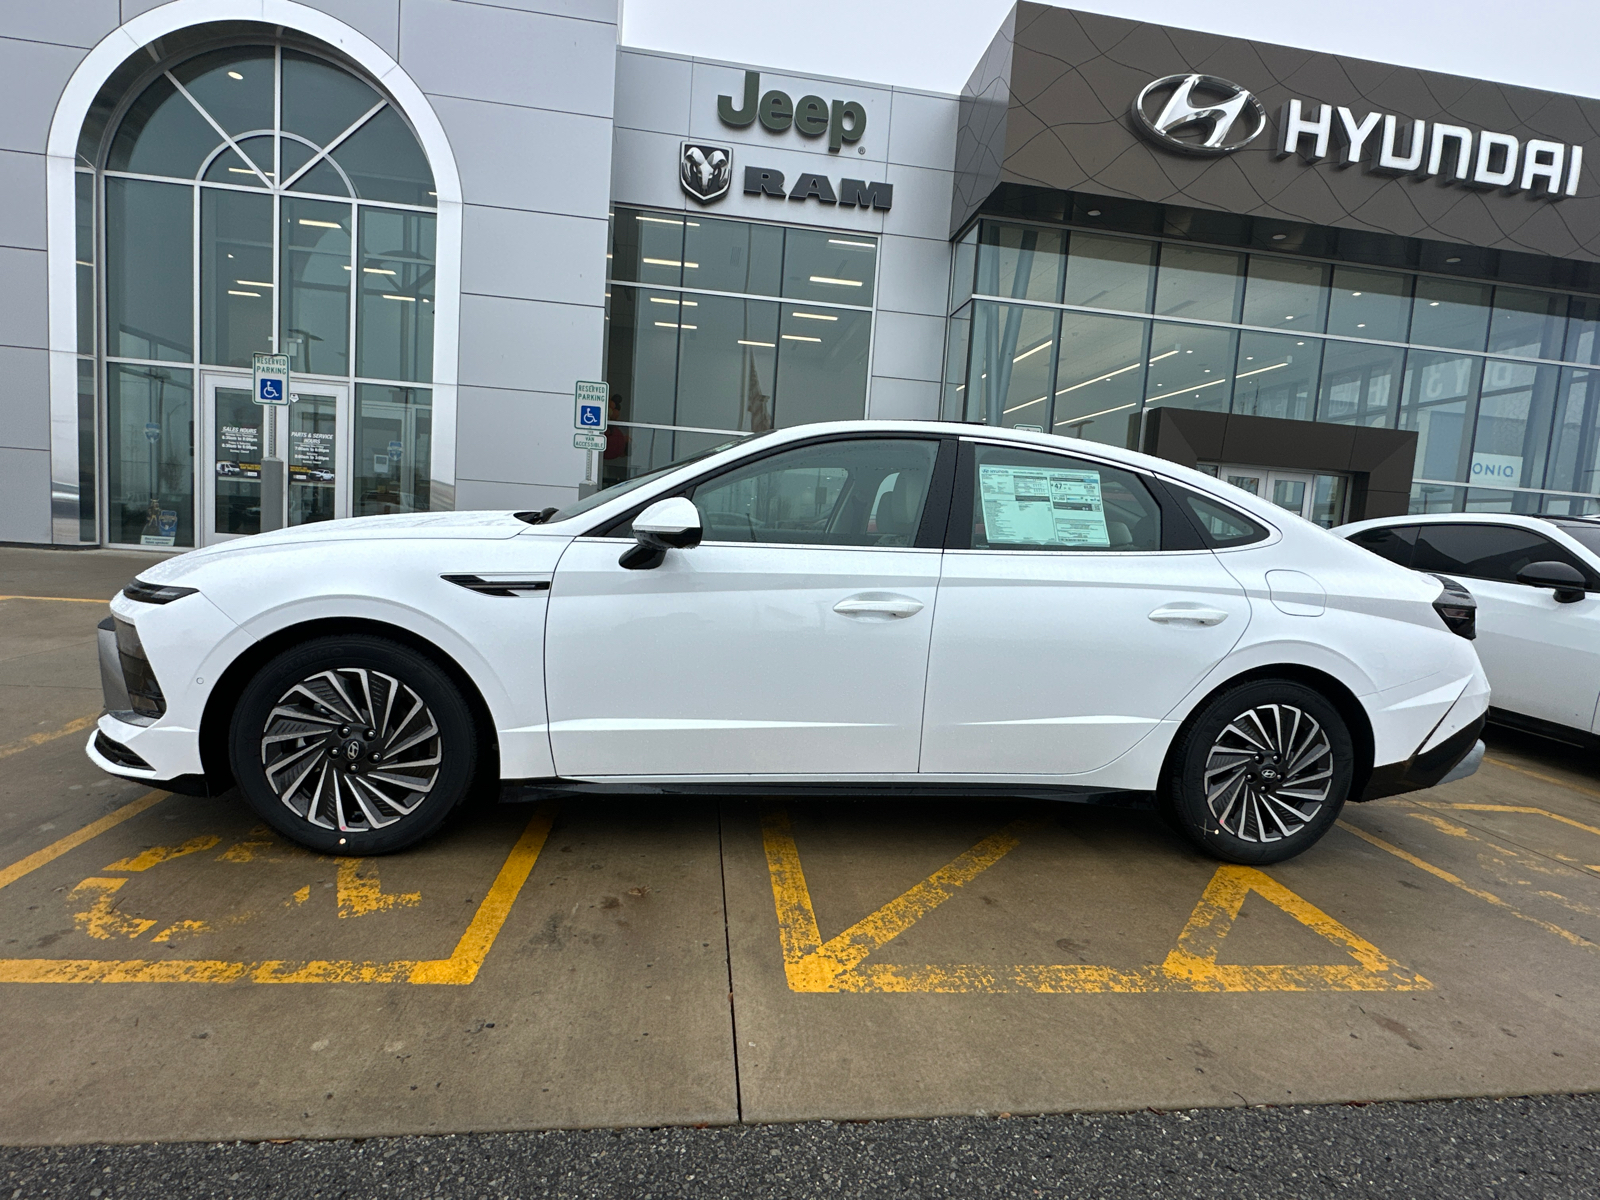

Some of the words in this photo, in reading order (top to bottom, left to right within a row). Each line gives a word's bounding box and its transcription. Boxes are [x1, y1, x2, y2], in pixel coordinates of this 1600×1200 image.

[717, 70, 867, 153] Jeep
[1279, 98, 1583, 197] HYUNDAI
[743, 165, 894, 211] RAM
[256, 356, 286, 366] RESERVED
[256, 366, 287, 375] PARKING
[578, 384, 605, 394] RESERVED
[577, 393, 605, 402] PARKING
